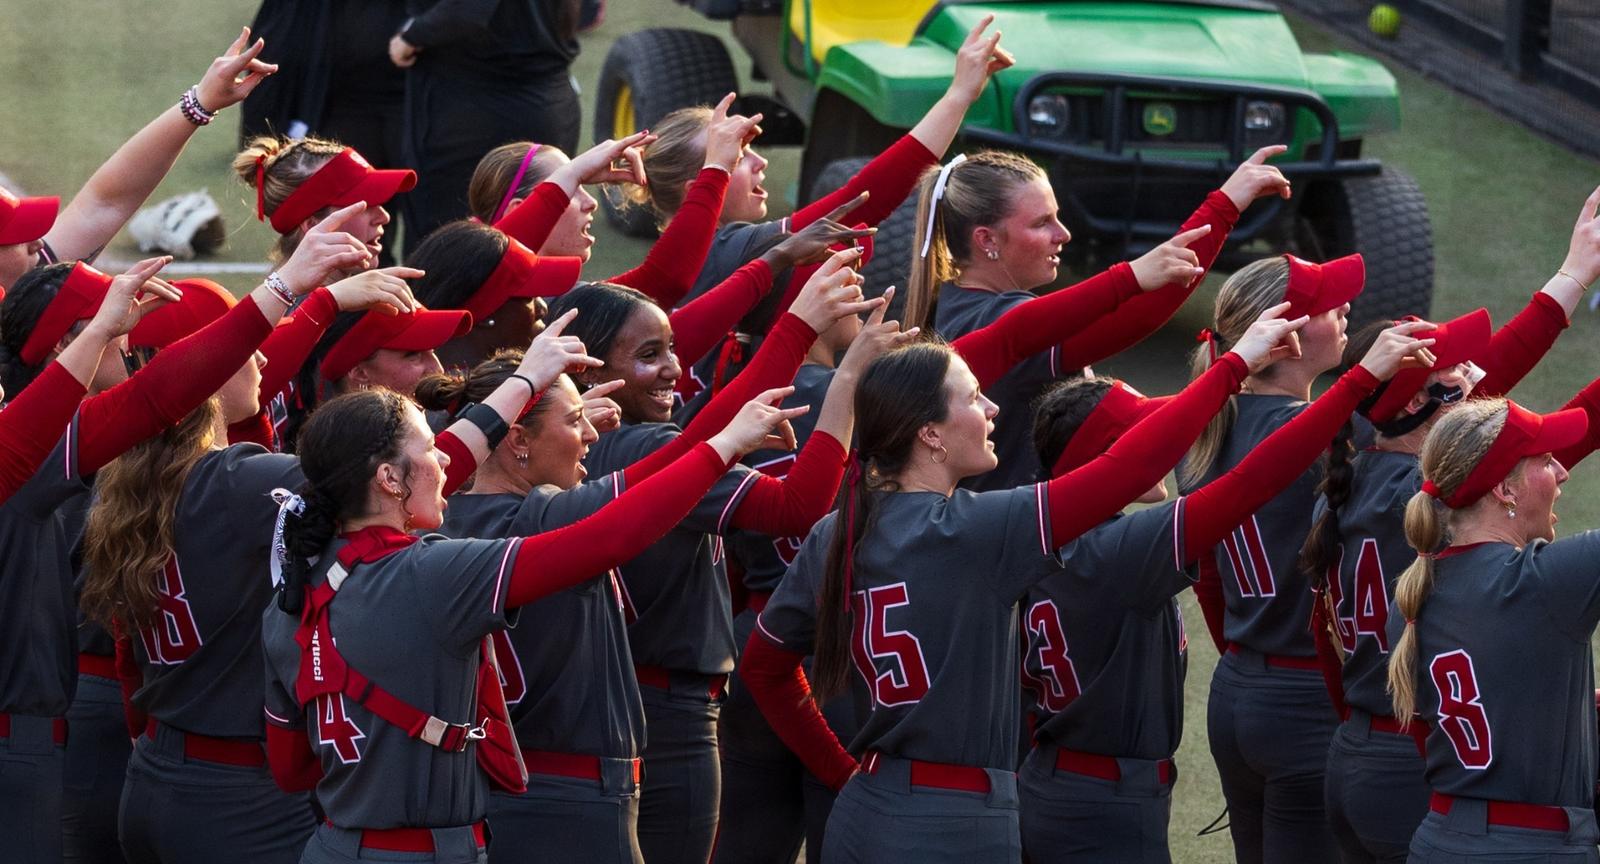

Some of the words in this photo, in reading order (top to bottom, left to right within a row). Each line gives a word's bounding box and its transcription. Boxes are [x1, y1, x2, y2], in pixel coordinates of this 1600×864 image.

[311, 624, 324, 682] arucci
[315, 636, 367, 764] 4
[850, 581, 931, 711] 15
[1429, 648, 1493, 770] 8
